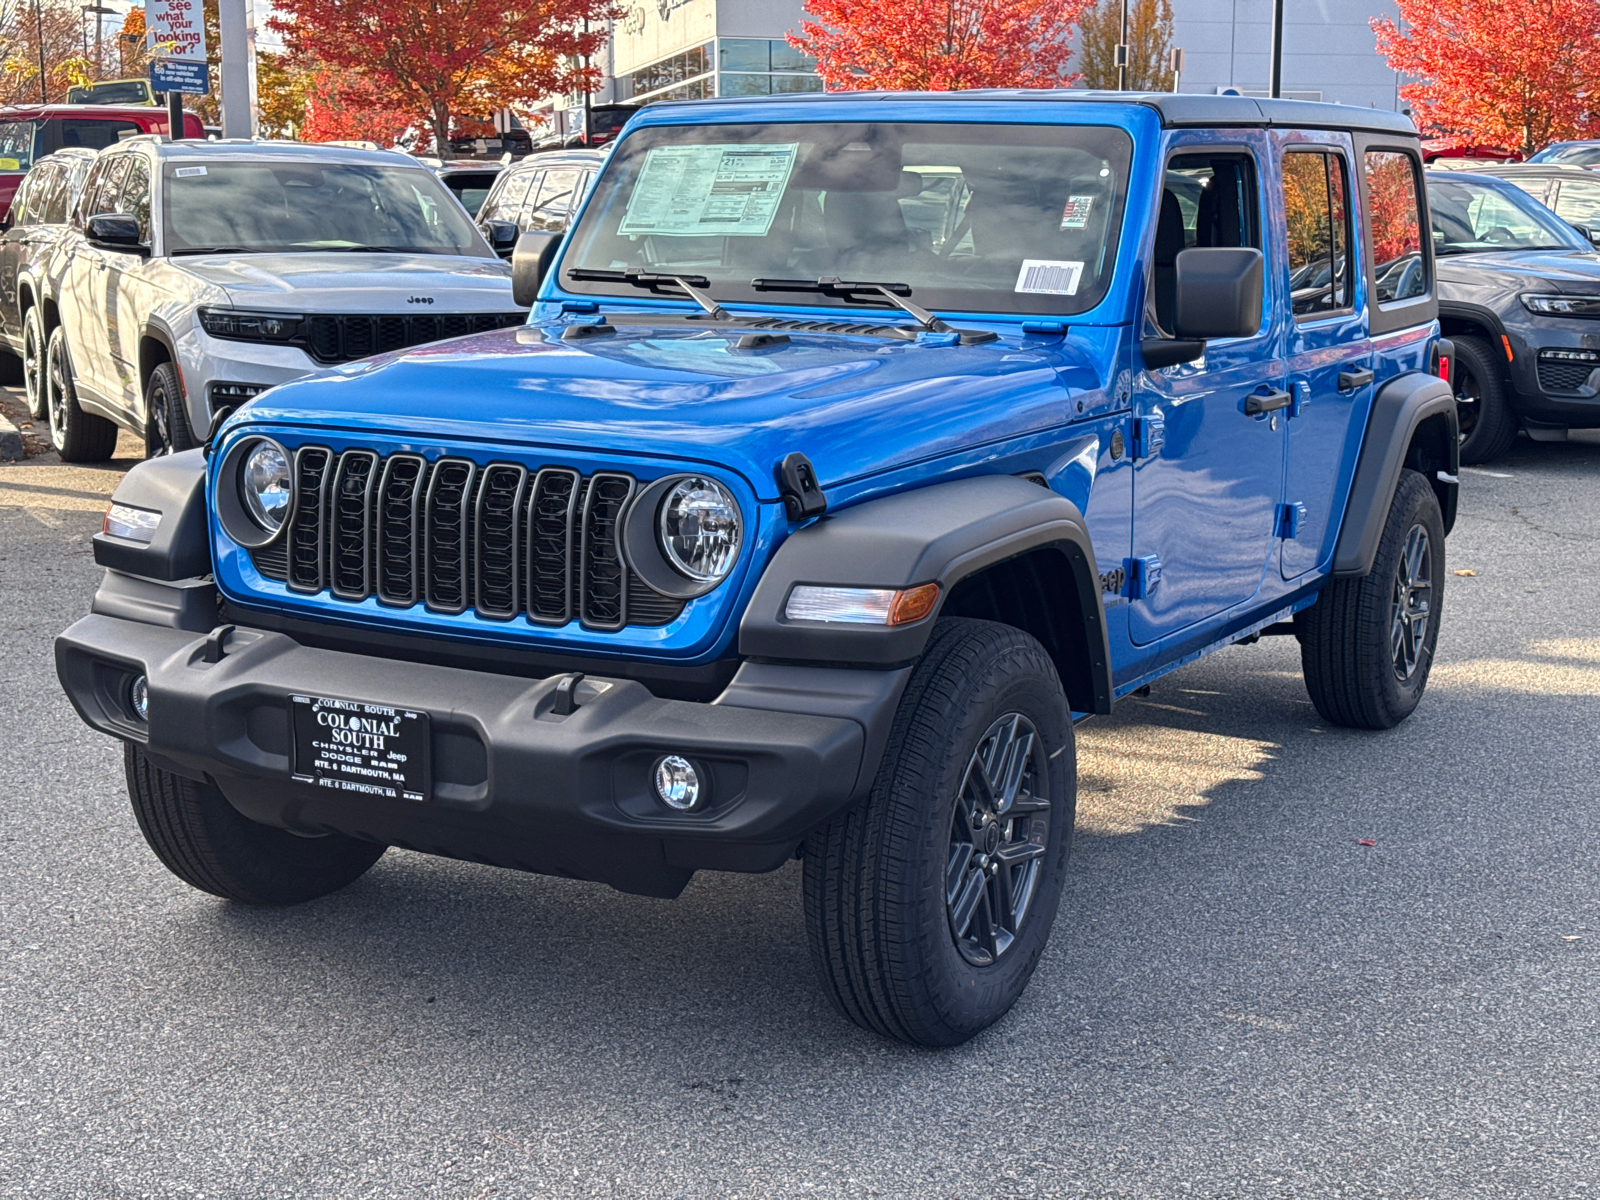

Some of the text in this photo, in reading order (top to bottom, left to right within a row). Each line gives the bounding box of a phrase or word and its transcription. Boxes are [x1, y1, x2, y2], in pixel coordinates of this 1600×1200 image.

[168, 1, 192, 11] see
[155, 11, 185, 21] what
[168, 20, 193, 31] your
[154, 30, 201, 44] looking
[724, 158, 735, 166] 21
[406, 295, 435, 306] Jeep
[1099, 566, 1126, 595] eep
[318, 698, 360, 712] COLONIAL
[364, 705, 395, 717] SOUTH
[316, 711, 400, 737] COLONIAL
[331, 728, 385, 750] SOUTH
[311, 741, 379, 757] CHRYSLER
[321, 750, 363, 764] DODGE
[386, 750, 408, 763] Jeep
[314, 759, 406, 782] RTE. 6 DARTMOUTH, MA
[370, 759, 398, 770] RAM
[319, 779, 335, 788] RTE.
[335, 781, 340, 789] 6
[341, 782, 385, 797] DARTMOUTH,
[385, 788, 397, 798] MA
